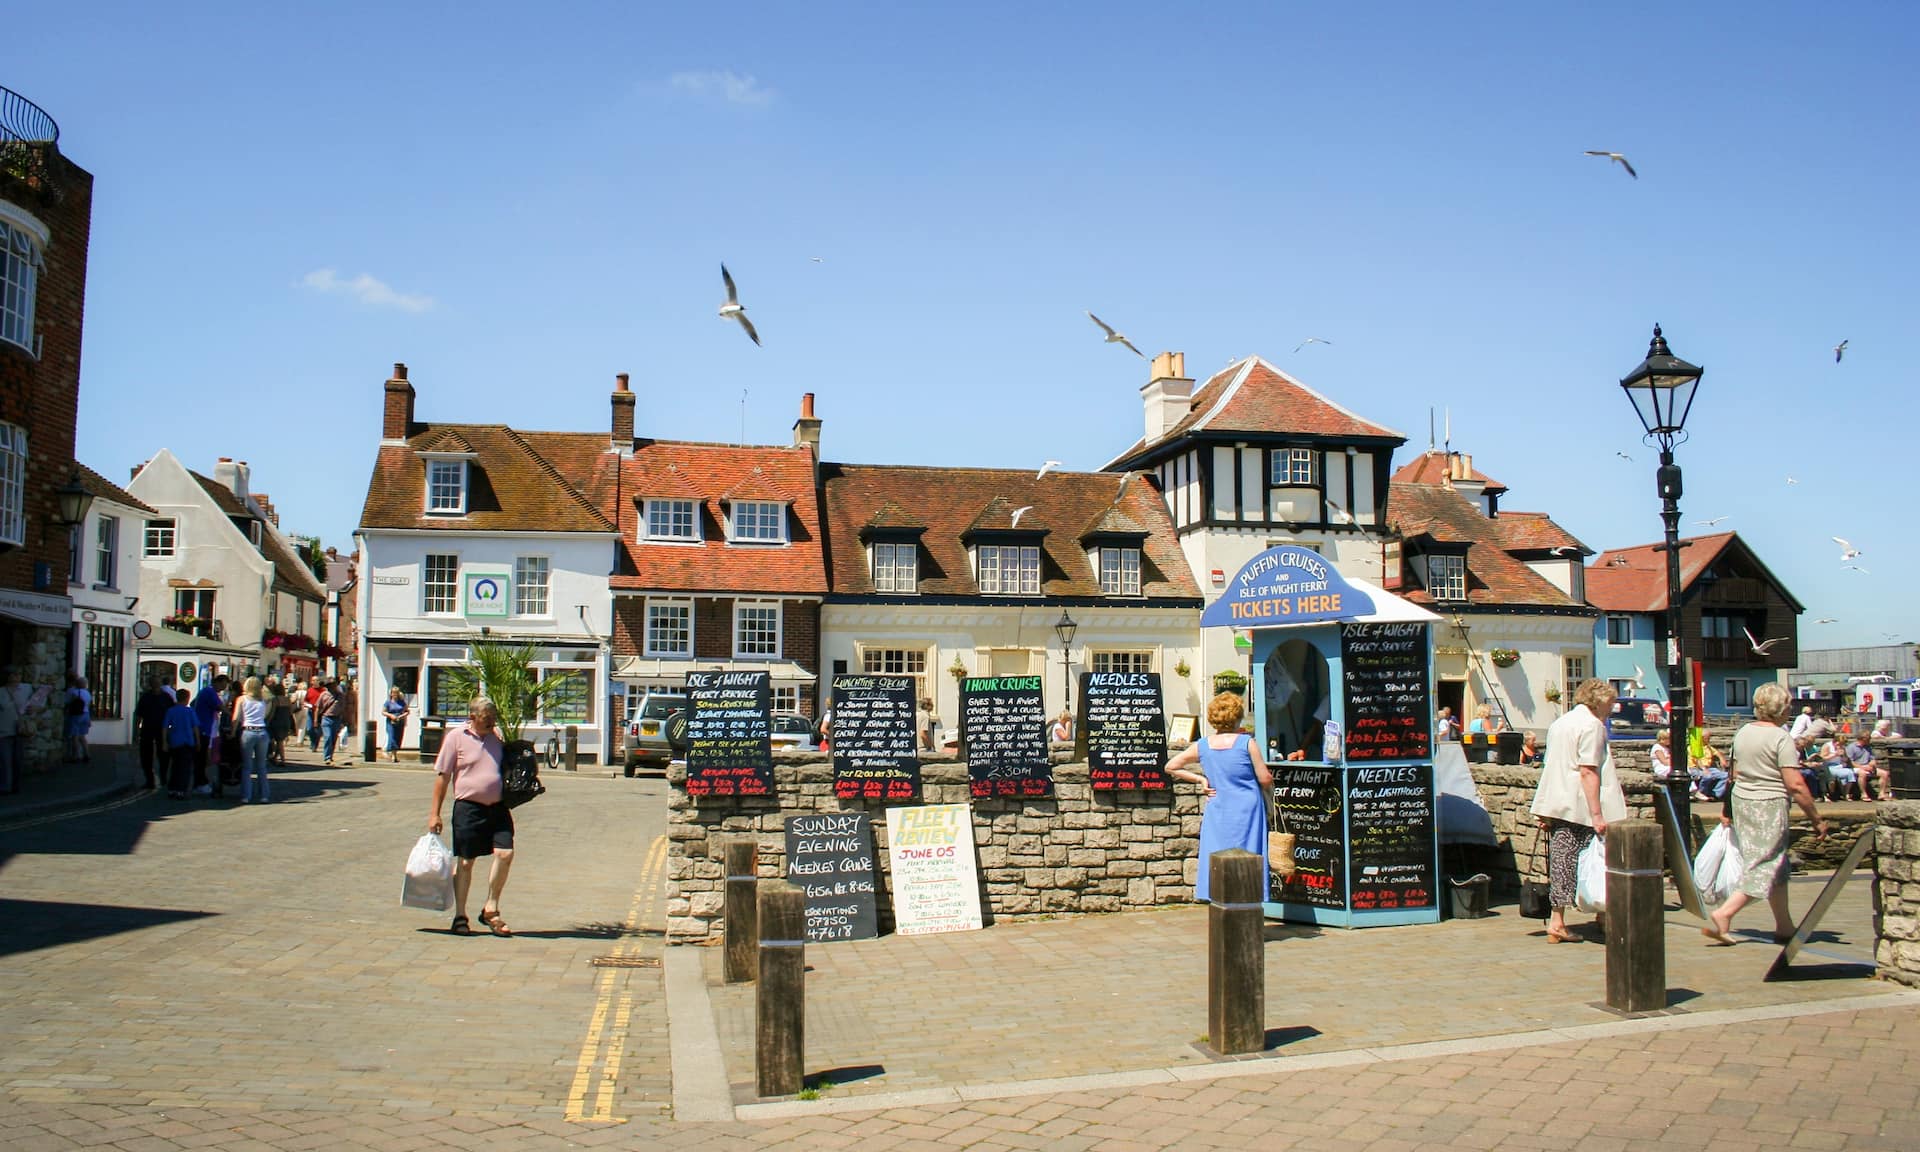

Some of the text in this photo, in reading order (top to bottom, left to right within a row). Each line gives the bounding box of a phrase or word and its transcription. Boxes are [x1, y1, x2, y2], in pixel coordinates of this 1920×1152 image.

[1240, 552, 1328, 587] PUFFIN CRUISES
[1275, 573, 1290, 582] AND
[1240, 580, 1328, 598] ISLE OF WIGHT FERRY
[1230, 594, 1342, 619] TICKETS HERE
[1342, 623, 1371, 638] ISLE
[1384, 623, 1425, 637] WIGHT
[1349, 641, 1379, 652] FERRY
[687, 673, 712, 688] ISLE
[722, 672, 766, 686] WIGHT
[971, 679, 999, 692] HOUR
[1000, 676, 1040, 690] CRUISE
[1089, 673, 1148, 686] NEEDLES
[690, 689, 758, 700] FERRY SERVICE
[1114, 687, 1158, 696] LIGHTHOUSE
[1293, 770, 1332, 784] WIGHT
[1356, 768, 1417, 784] NEEDLES
[1274, 787, 1316, 798] EXT FERRY
[1378, 786, 1426, 798] LIGHTHOUSE
[792, 816, 862, 832] SUNDAY
[899, 806, 966, 829] FLEET
[894, 826, 961, 846] REVIEW
[796, 838, 862, 854] EVENING
[898, 846, 956, 860] JUNE 05
[1294, 846, 1322, 860] CRUISE
[790, 856, 874, 874] NEEDLES CRUISE
[804, 904, 858, 917] ESERVATIONS
